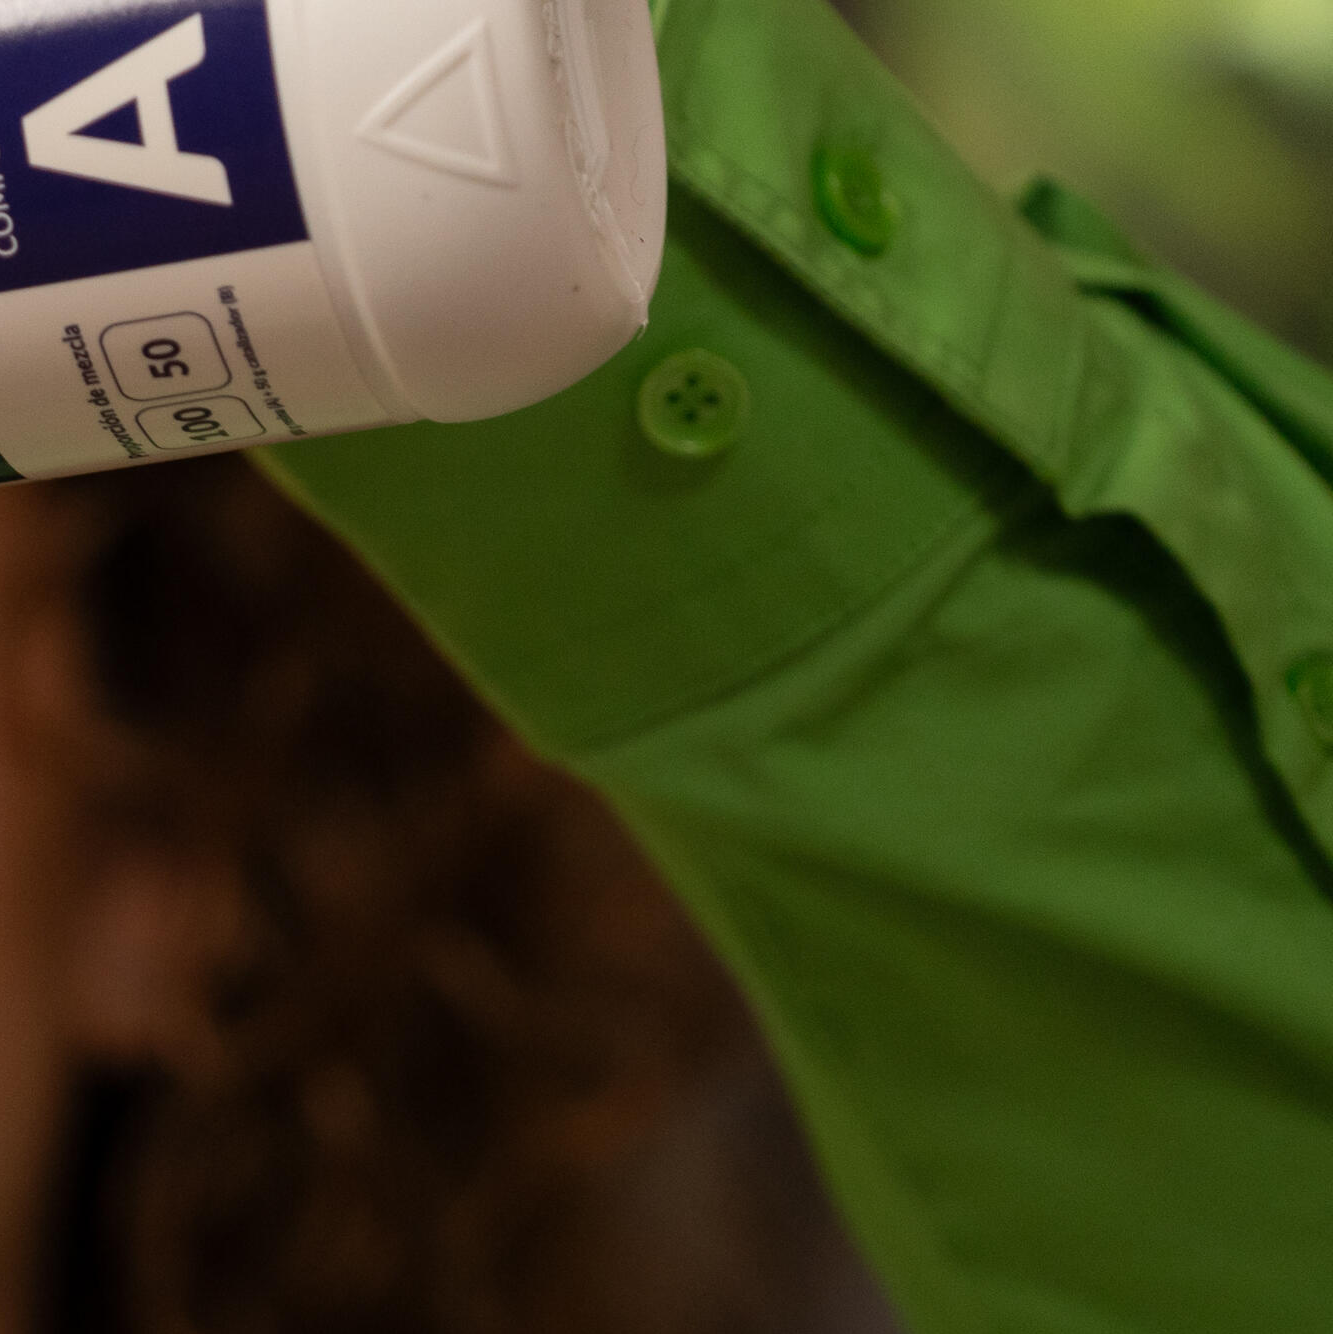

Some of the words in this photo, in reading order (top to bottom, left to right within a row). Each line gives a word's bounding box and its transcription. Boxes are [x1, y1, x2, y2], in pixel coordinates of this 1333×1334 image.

[20, 12, 235, 208] A
[61, 323, 102, 386] mezcla
[141, 337, 190, 379] 50
[88, 386, 110, 407] de
[173, 406, 230, 442] 100
